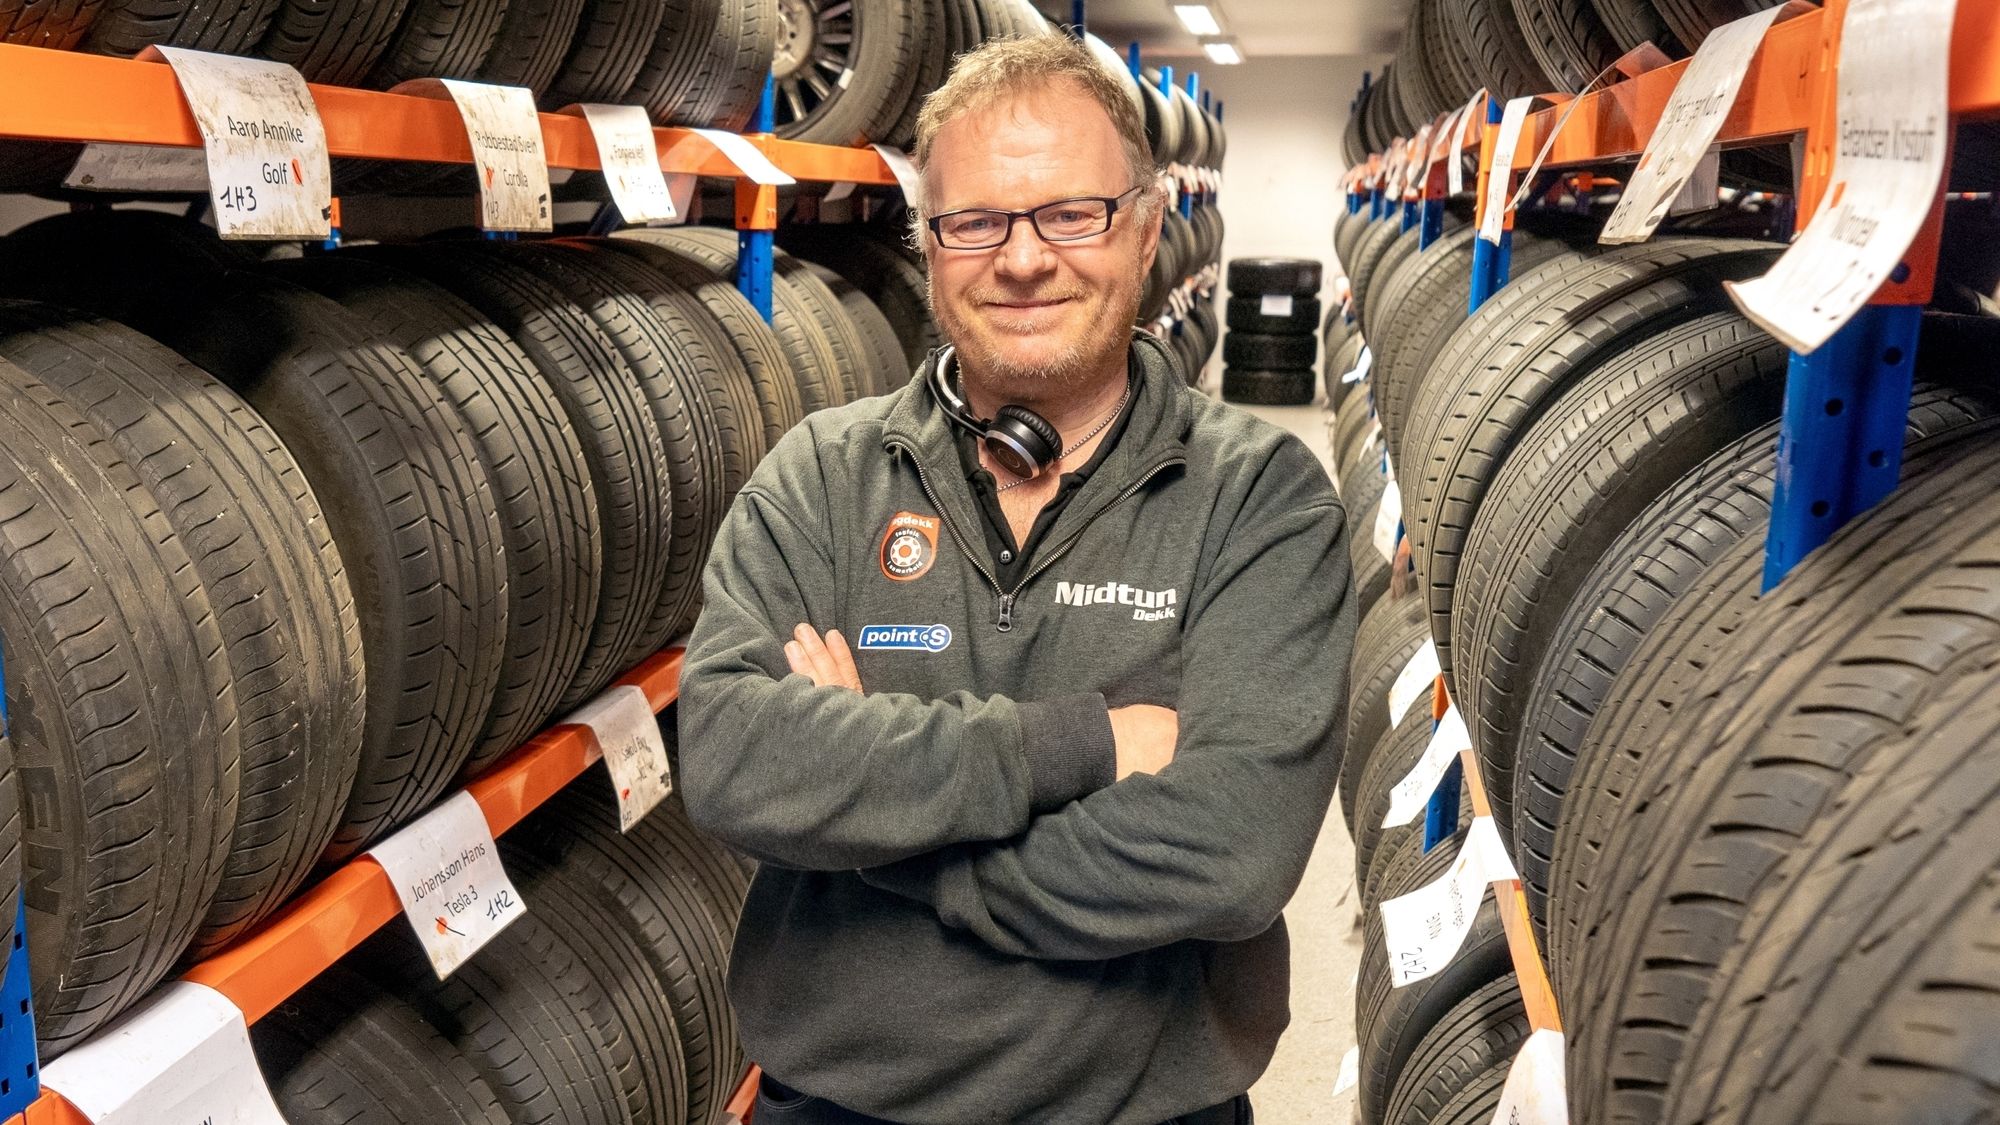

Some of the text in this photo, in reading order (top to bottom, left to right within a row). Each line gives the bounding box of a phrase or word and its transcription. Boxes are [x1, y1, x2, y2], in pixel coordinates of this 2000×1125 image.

[227, 115, 304, 143] Aarø Annike
[262, 162, 287, 184] Golf
[220, 185, 257, 212] 1H3
[1054, 581, 1177, 609] Midtun
[1132, 606, 1176, 622] Dekk
[866, 628, 947, 647] point S
[411, 843, 486, 902] Johansson Hans
[444, 884, 478, 917] Tesla 3
[486, 889, 515, 920] 1H2
[1401, 946, 1427, 981] 2H2
